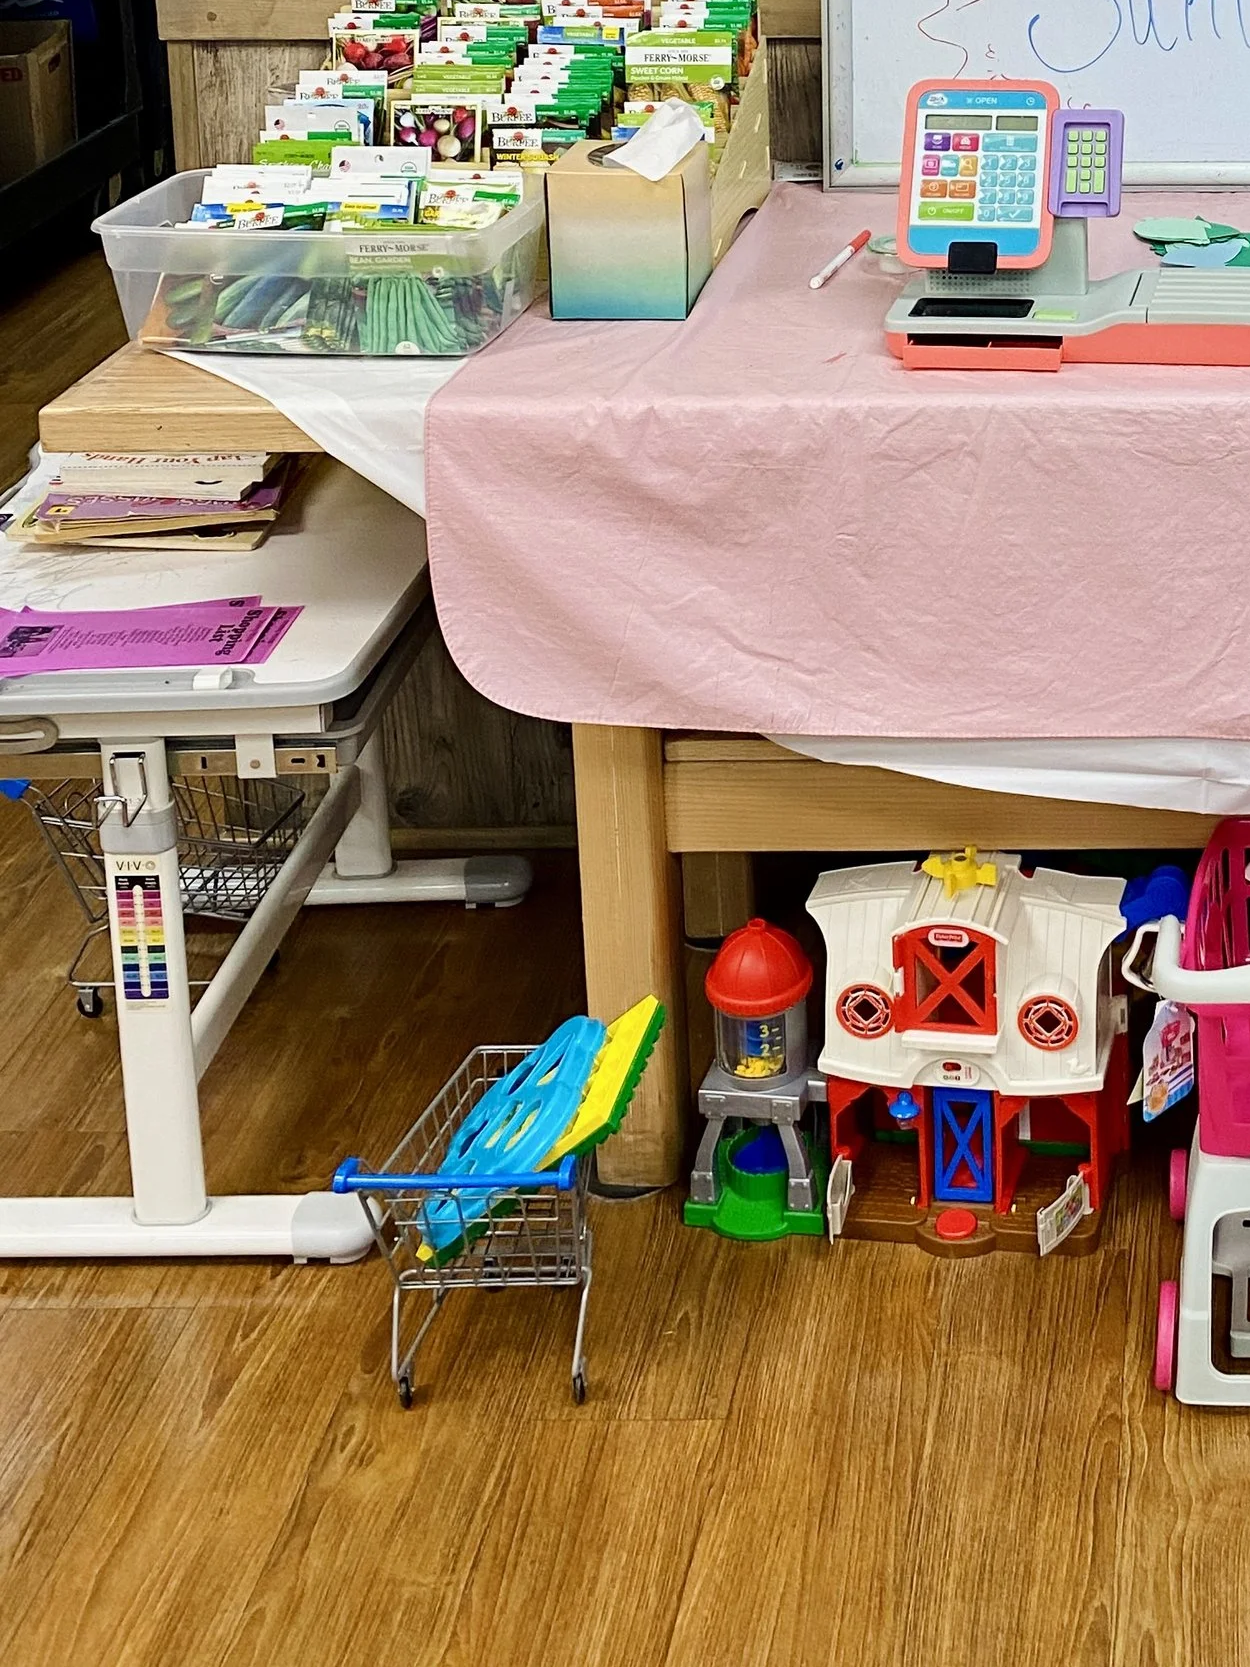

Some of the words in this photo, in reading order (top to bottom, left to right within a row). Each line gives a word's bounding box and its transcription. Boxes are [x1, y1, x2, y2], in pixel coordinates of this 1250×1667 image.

[630, 67, 657, 76] SWEET
[659, 67, 684, 76] CORN
[974, 96, 998, 105] OPEN
[208, 623, 234, 644] List
[215, 609, 264, 657] Shopping
